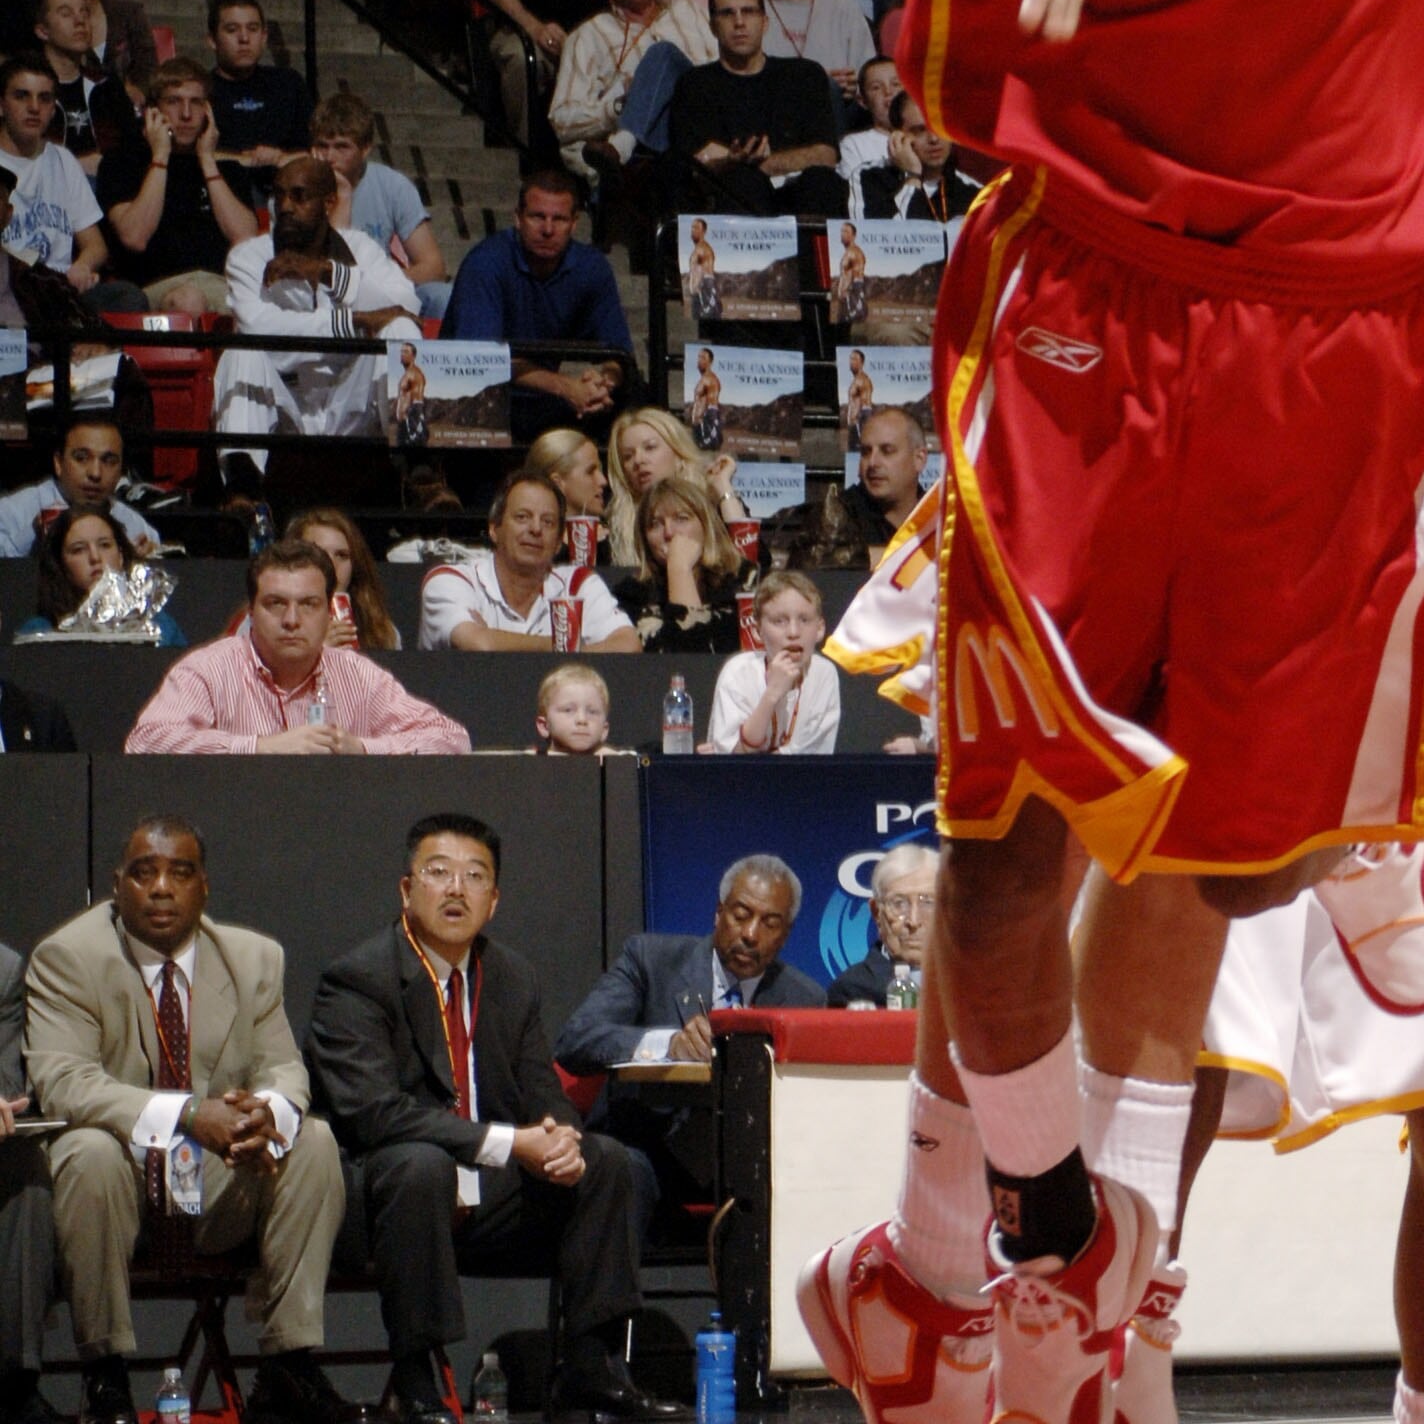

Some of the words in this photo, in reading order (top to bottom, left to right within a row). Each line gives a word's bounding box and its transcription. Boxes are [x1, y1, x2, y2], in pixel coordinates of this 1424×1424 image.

[711, 229, 740, 240] NICK
[744, 229, 794, 240] CANNON
[861, 233, 890, 244] NICK
[894, 233, 940, 244] CANNON
[421, 354, 451, 365] NICK
[455, 354, 506, 365] CANNON
[718, 360, 746, 373] NICK
[750, 363, 800, 376] CANNON
[869, 360, 896, 371] NICK
[750, 477, 801, 488] CANNON
